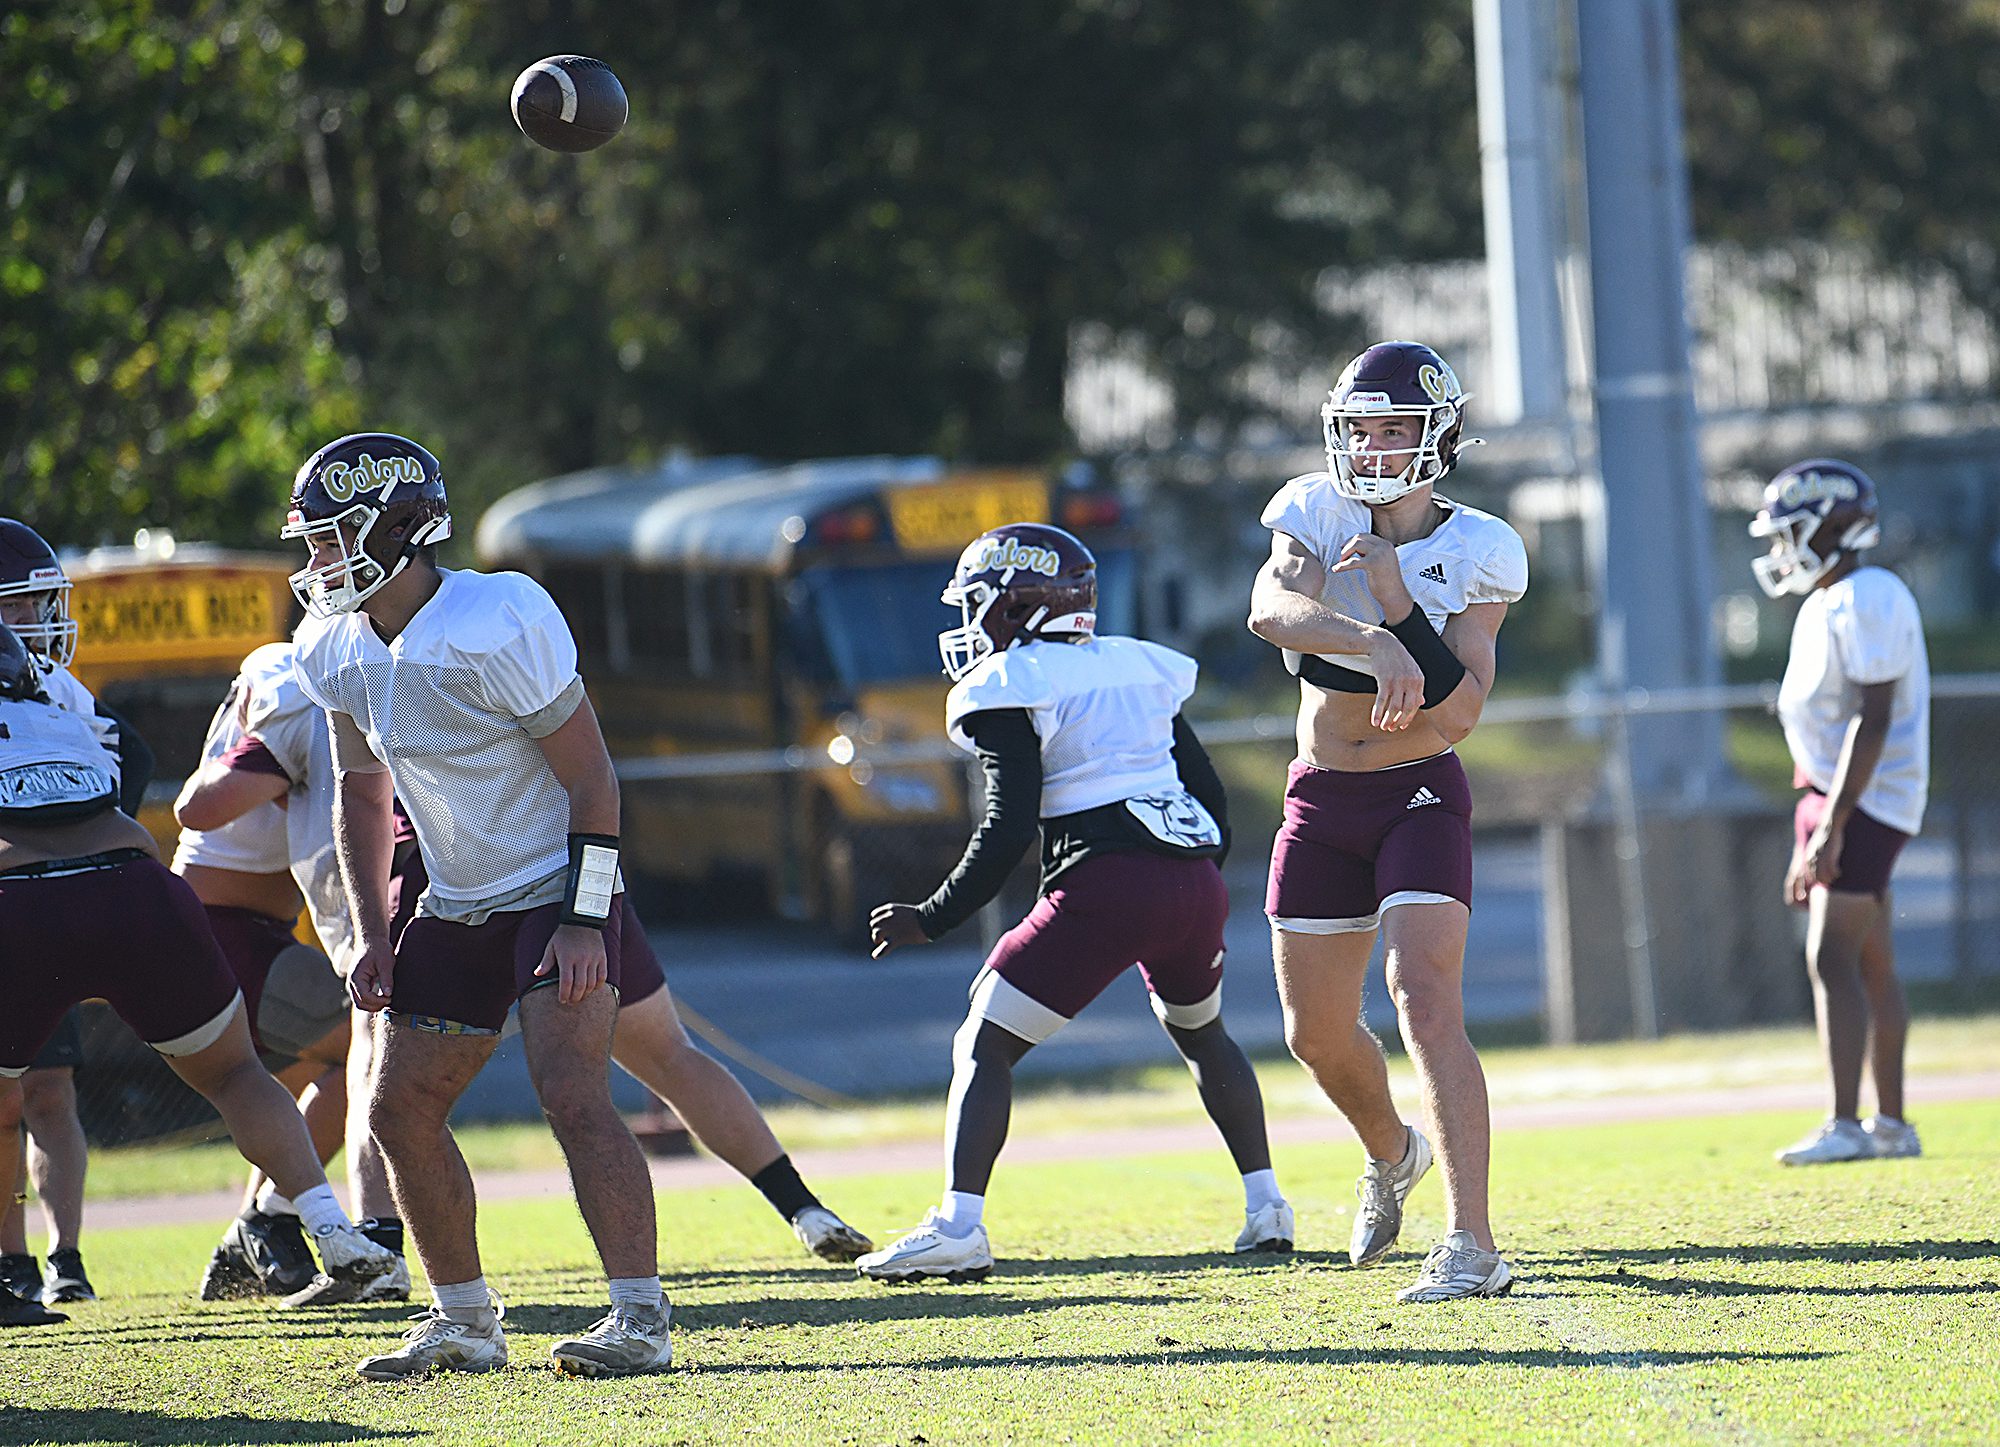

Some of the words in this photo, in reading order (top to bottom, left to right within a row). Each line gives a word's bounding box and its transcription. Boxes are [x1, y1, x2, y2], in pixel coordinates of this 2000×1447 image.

[321, 453, 425, 503] Gators
[1419, 571, 1447, 585] adidas
[1406, 797, 1441, 809] adidas
